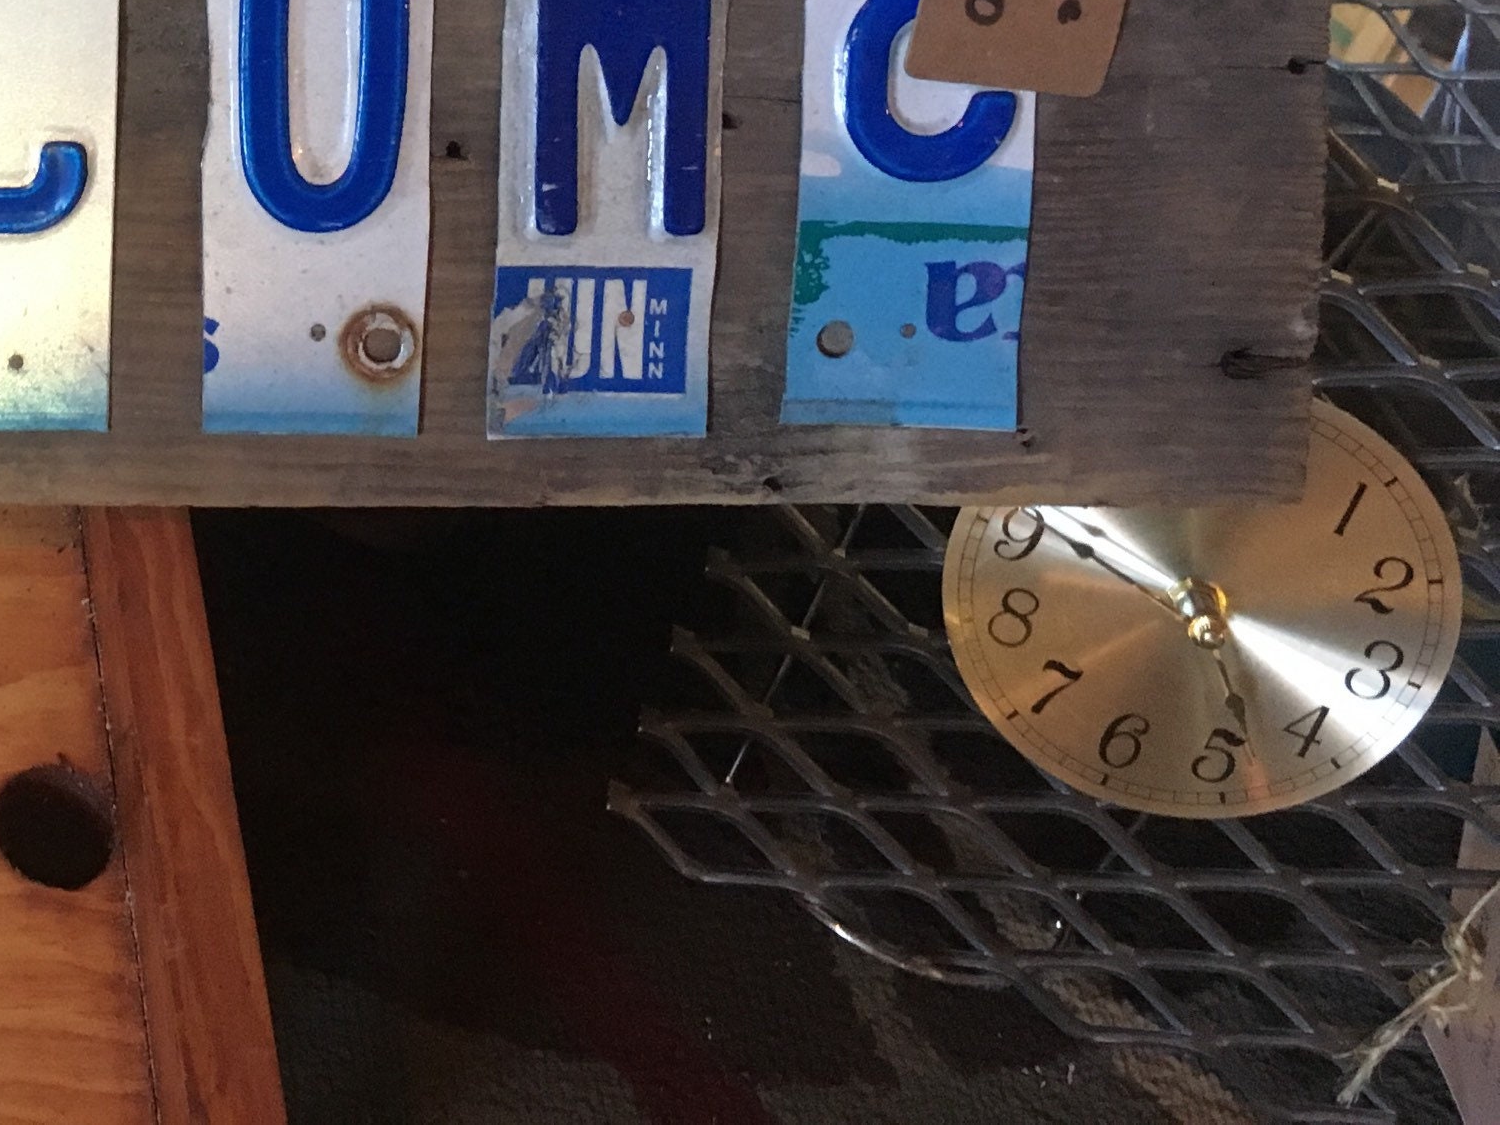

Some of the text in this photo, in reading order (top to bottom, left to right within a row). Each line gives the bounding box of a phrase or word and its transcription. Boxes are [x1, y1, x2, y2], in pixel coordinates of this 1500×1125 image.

[647, 298, 668, 380] MINN
[993, 504, 1047, 561] 9
[1333, 482, 1369, 537] 1
[1354, 555, 1416, 615] 2
[987, 587, 1041, 649] 8
[1031, 659, 1084, 715] 7
[1344, 639, 1405, 701] 3
[1098, 713, 1151, 769] 6
[1190, 726, 1247, 784] 5
[1283, 704, 1331, 760] 4
